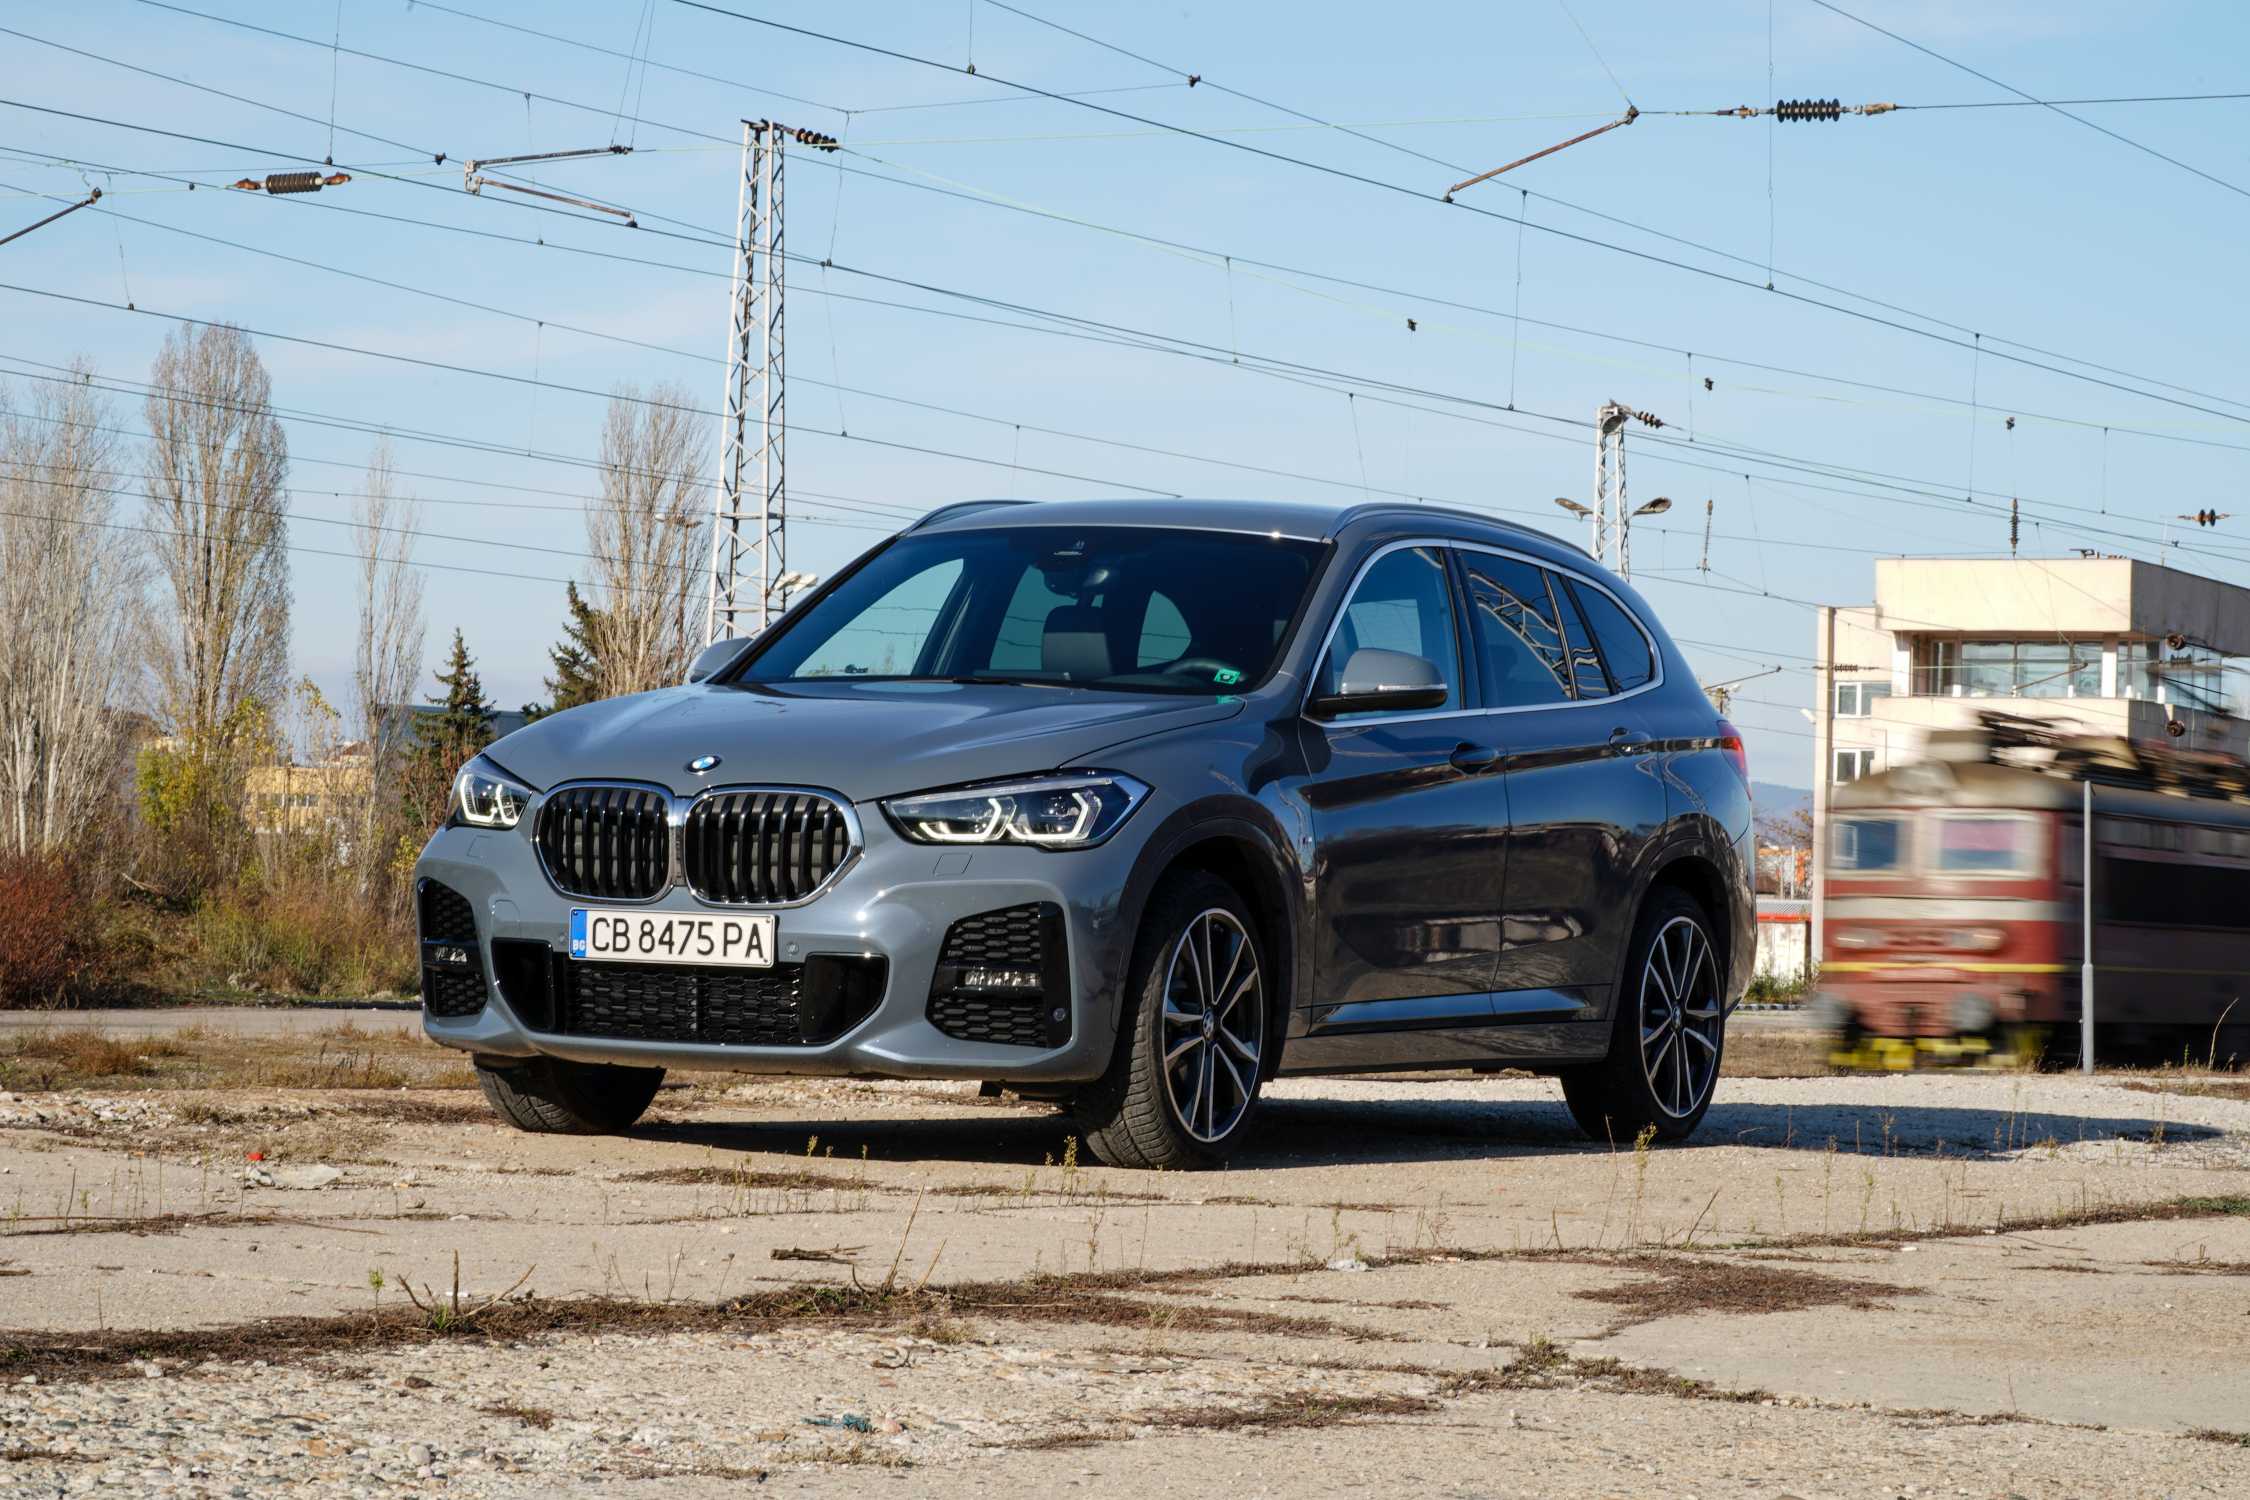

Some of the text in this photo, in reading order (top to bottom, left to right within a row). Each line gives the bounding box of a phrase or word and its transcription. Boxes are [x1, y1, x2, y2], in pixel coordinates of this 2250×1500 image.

[572, 939, 586, 951] BG
[592, 917, 764, 959] CB 8475 PA
